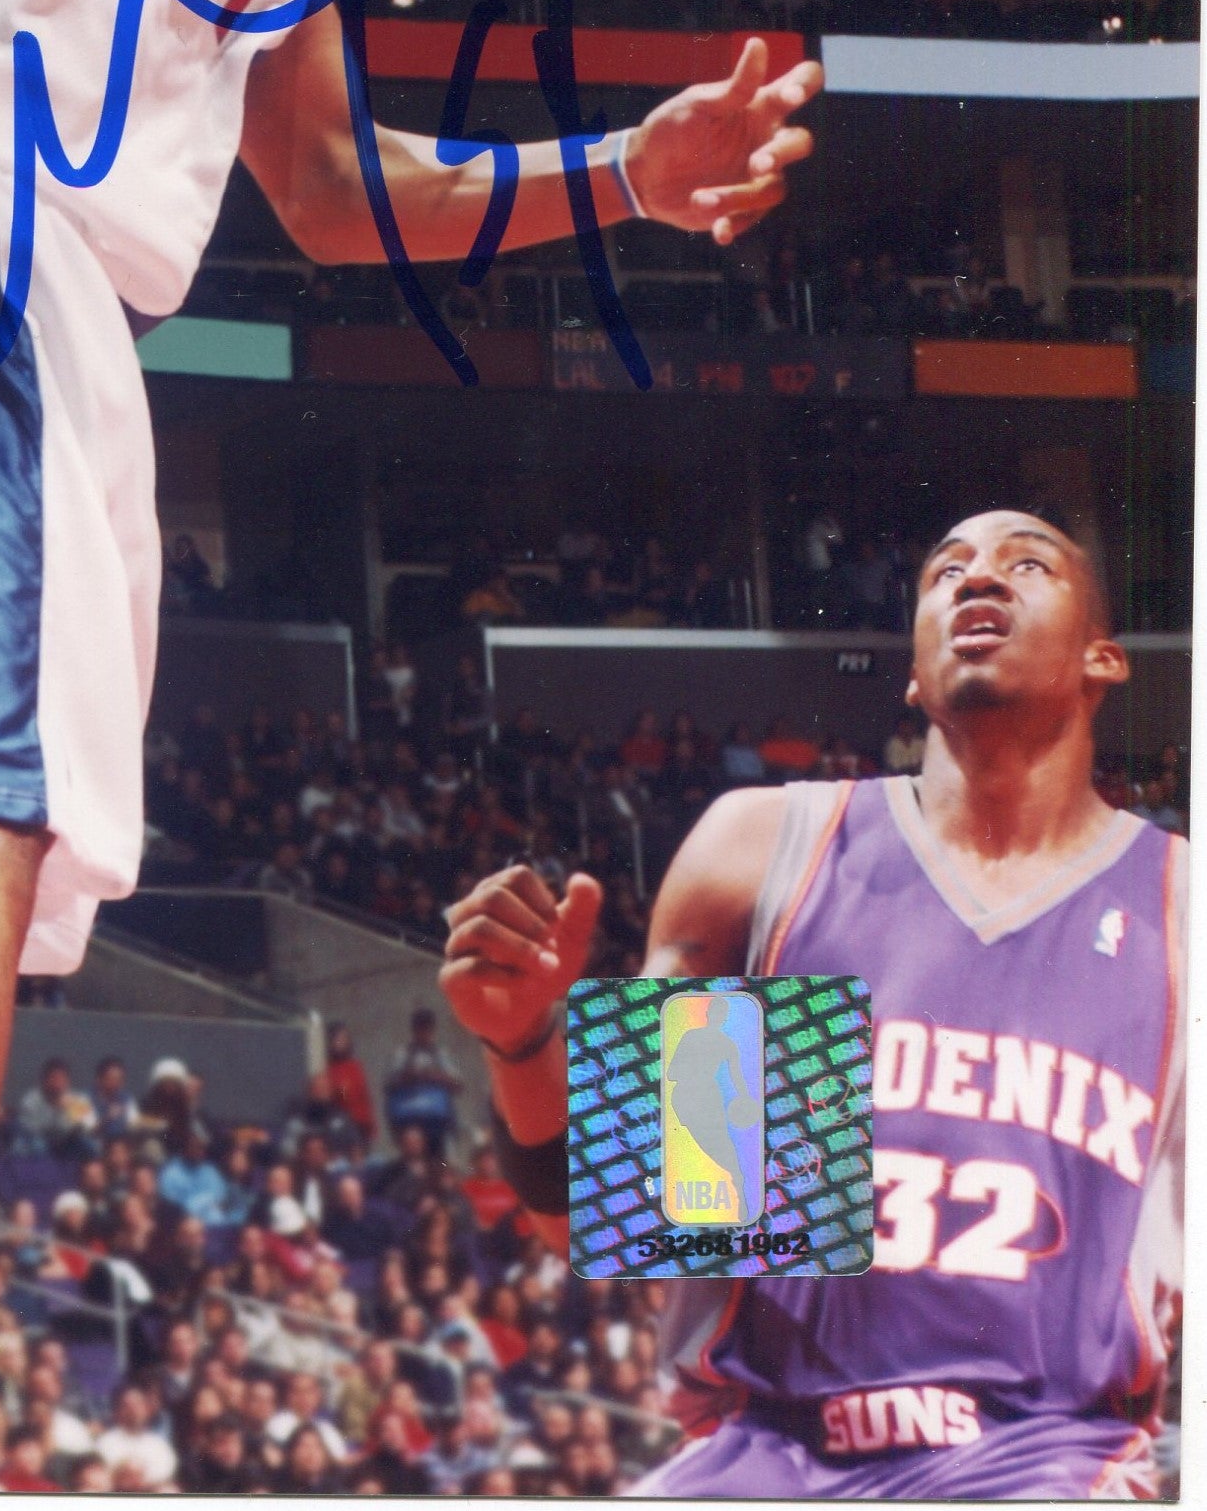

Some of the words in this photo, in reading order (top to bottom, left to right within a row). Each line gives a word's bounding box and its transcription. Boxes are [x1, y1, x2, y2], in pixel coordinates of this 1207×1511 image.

[872, 1019, 1156, 1187] OENIX
[676, 1181, 732, 1210] NBA
[872, 1149, 1038, 1282] 32
[637, 1232, 811, 1257] 532681982
[823, 1386, 983, 1452] SUNS
